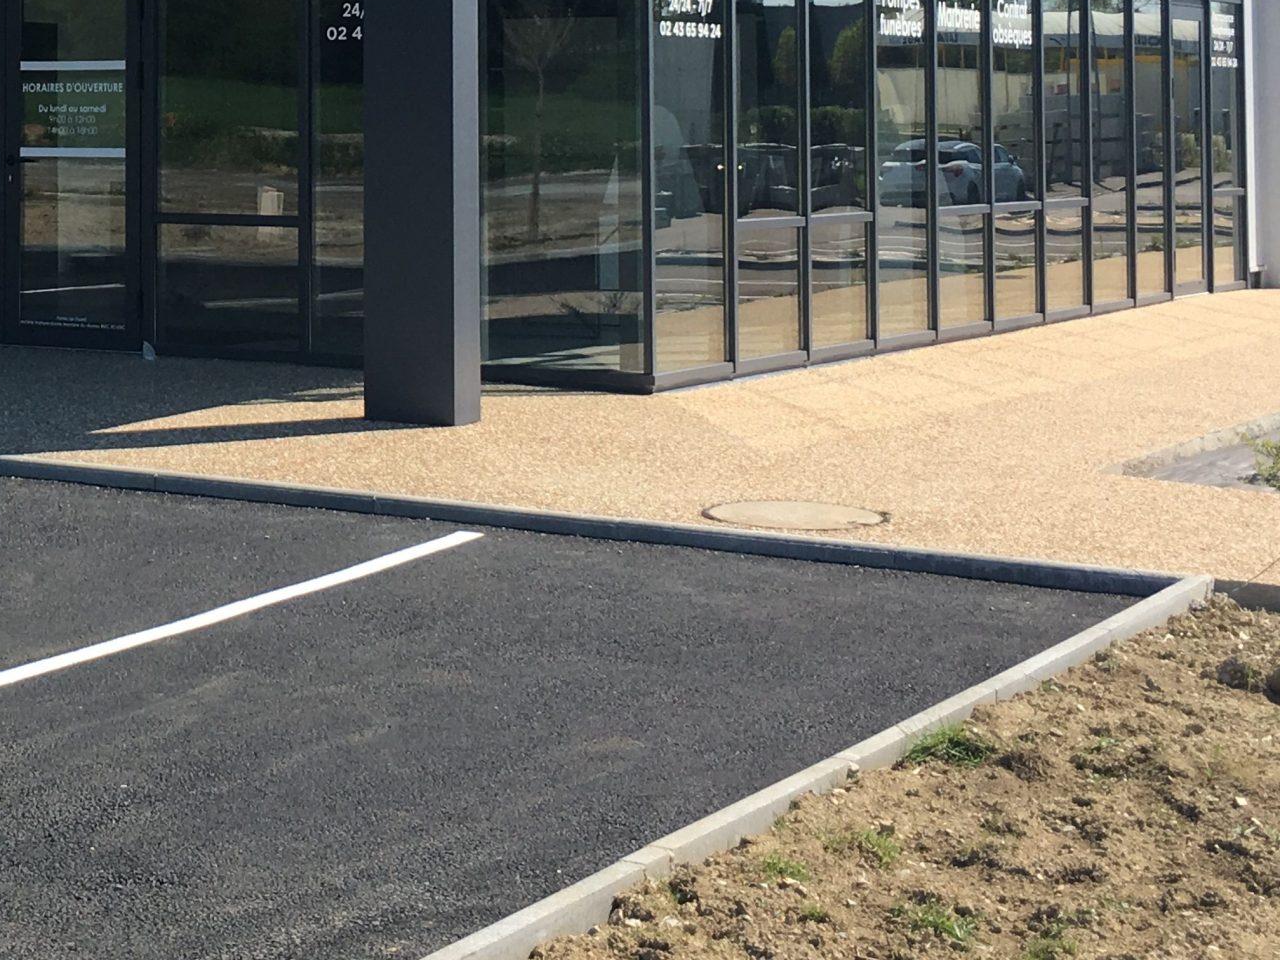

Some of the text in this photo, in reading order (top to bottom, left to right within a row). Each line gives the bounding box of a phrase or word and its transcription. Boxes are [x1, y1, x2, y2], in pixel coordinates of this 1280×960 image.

[937, 1, 980, 29] Marbrerie
[326, 26, 347, 41] 02
[660, 20, 722, 39] 02 43 65 94 24
[879, 13, 922, 38] funèbres
[992, 23, 1032, 49] obsèques
[22, 82, 123, 93] HORAIRES D'OUVERTURE
[38, 105, 48, 113] Du
[49, 104, 67, 113] lundi
[79, 104, 107, 113] samedi
